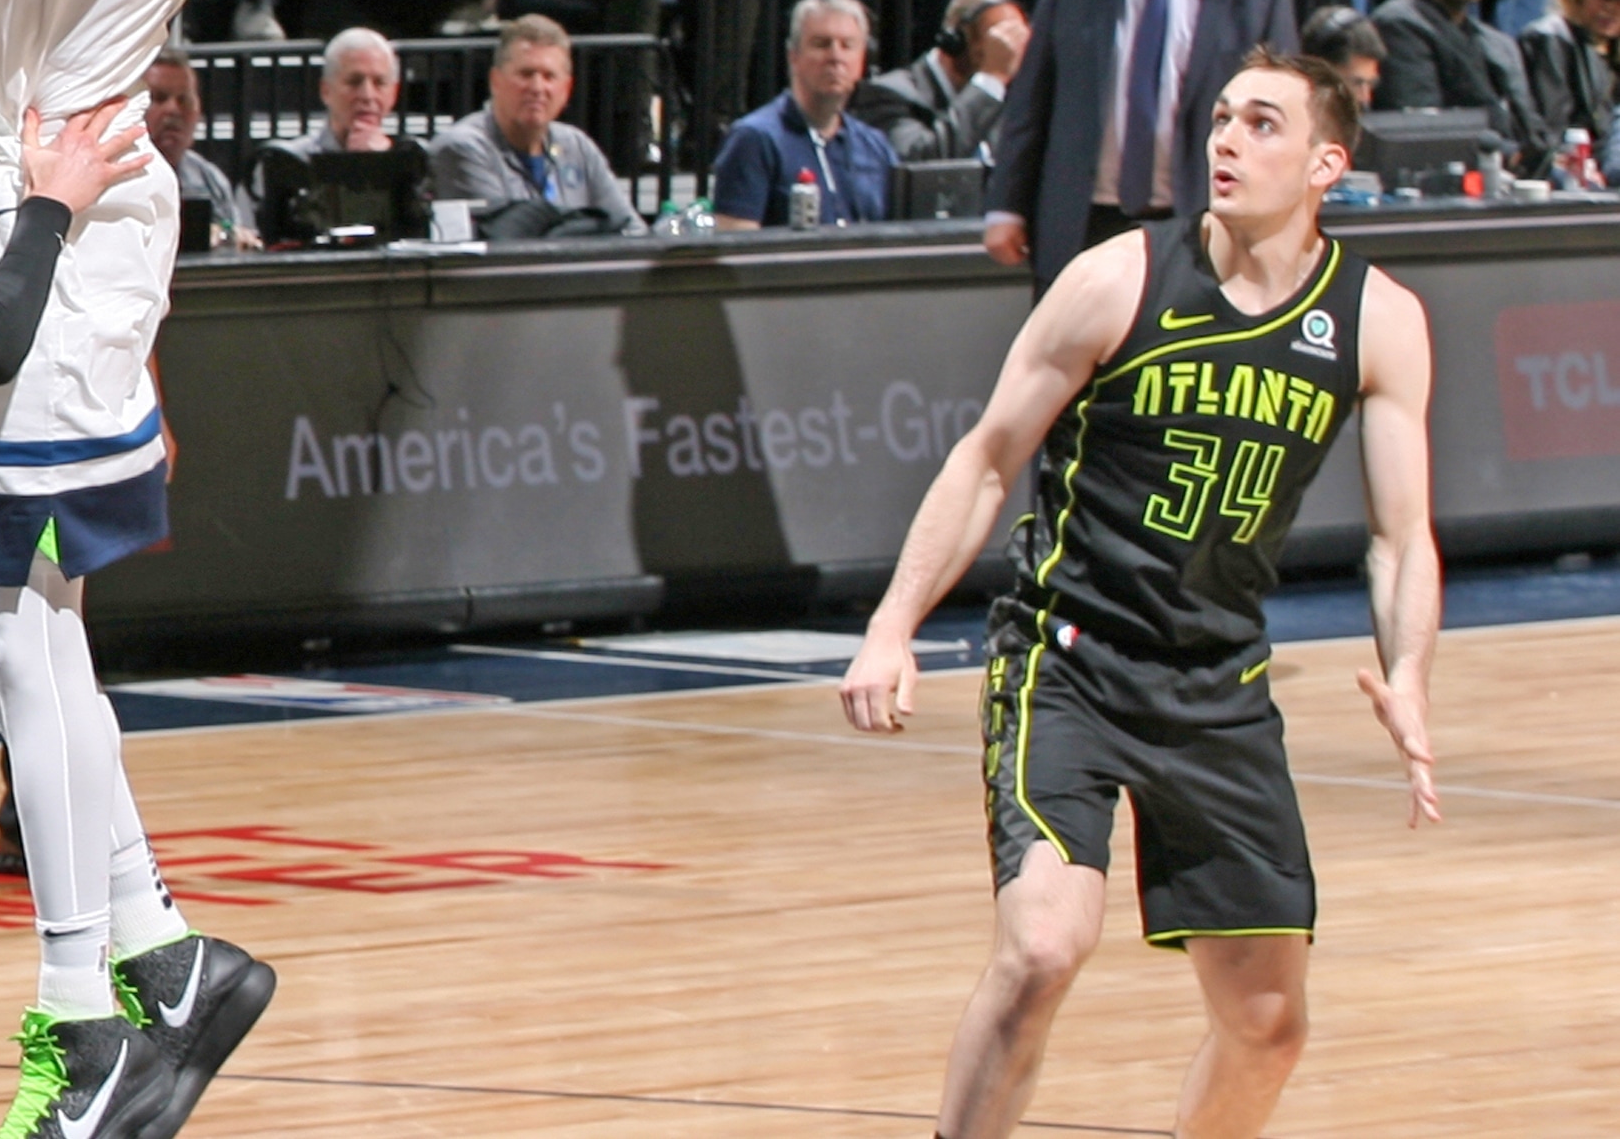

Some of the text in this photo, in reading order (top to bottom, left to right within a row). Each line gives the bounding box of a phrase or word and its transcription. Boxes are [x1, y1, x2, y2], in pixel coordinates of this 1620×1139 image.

[1132, 363, 1335, 444] ATLANTA
[1514, 350, 1620, 410] TCL
[1142, 428, 1286, 545] 34
